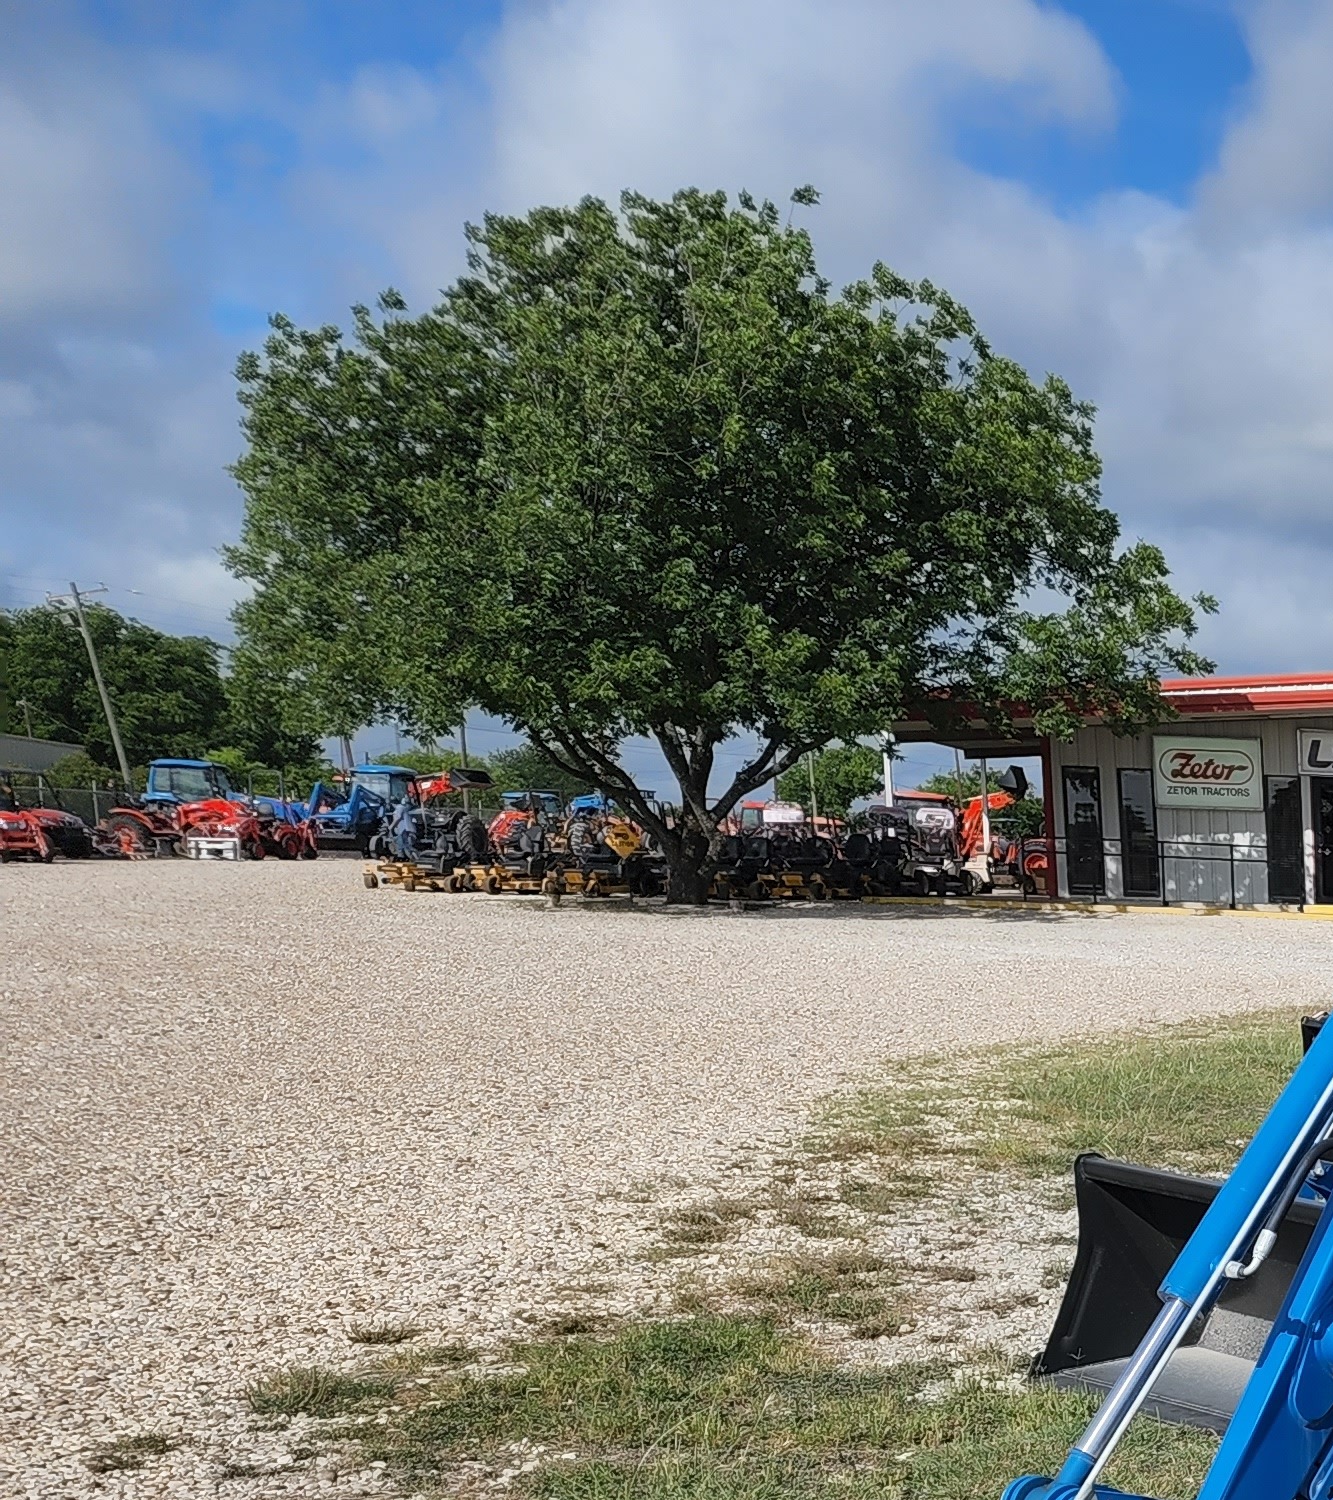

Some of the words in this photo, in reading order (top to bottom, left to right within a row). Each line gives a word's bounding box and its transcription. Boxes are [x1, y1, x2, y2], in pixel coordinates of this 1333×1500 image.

[1170, 752, 1249, 780] Zetor
[1167, 786, 1198, 795] ZETOR
[1201, 787, 1250, 797] TRACTORS
